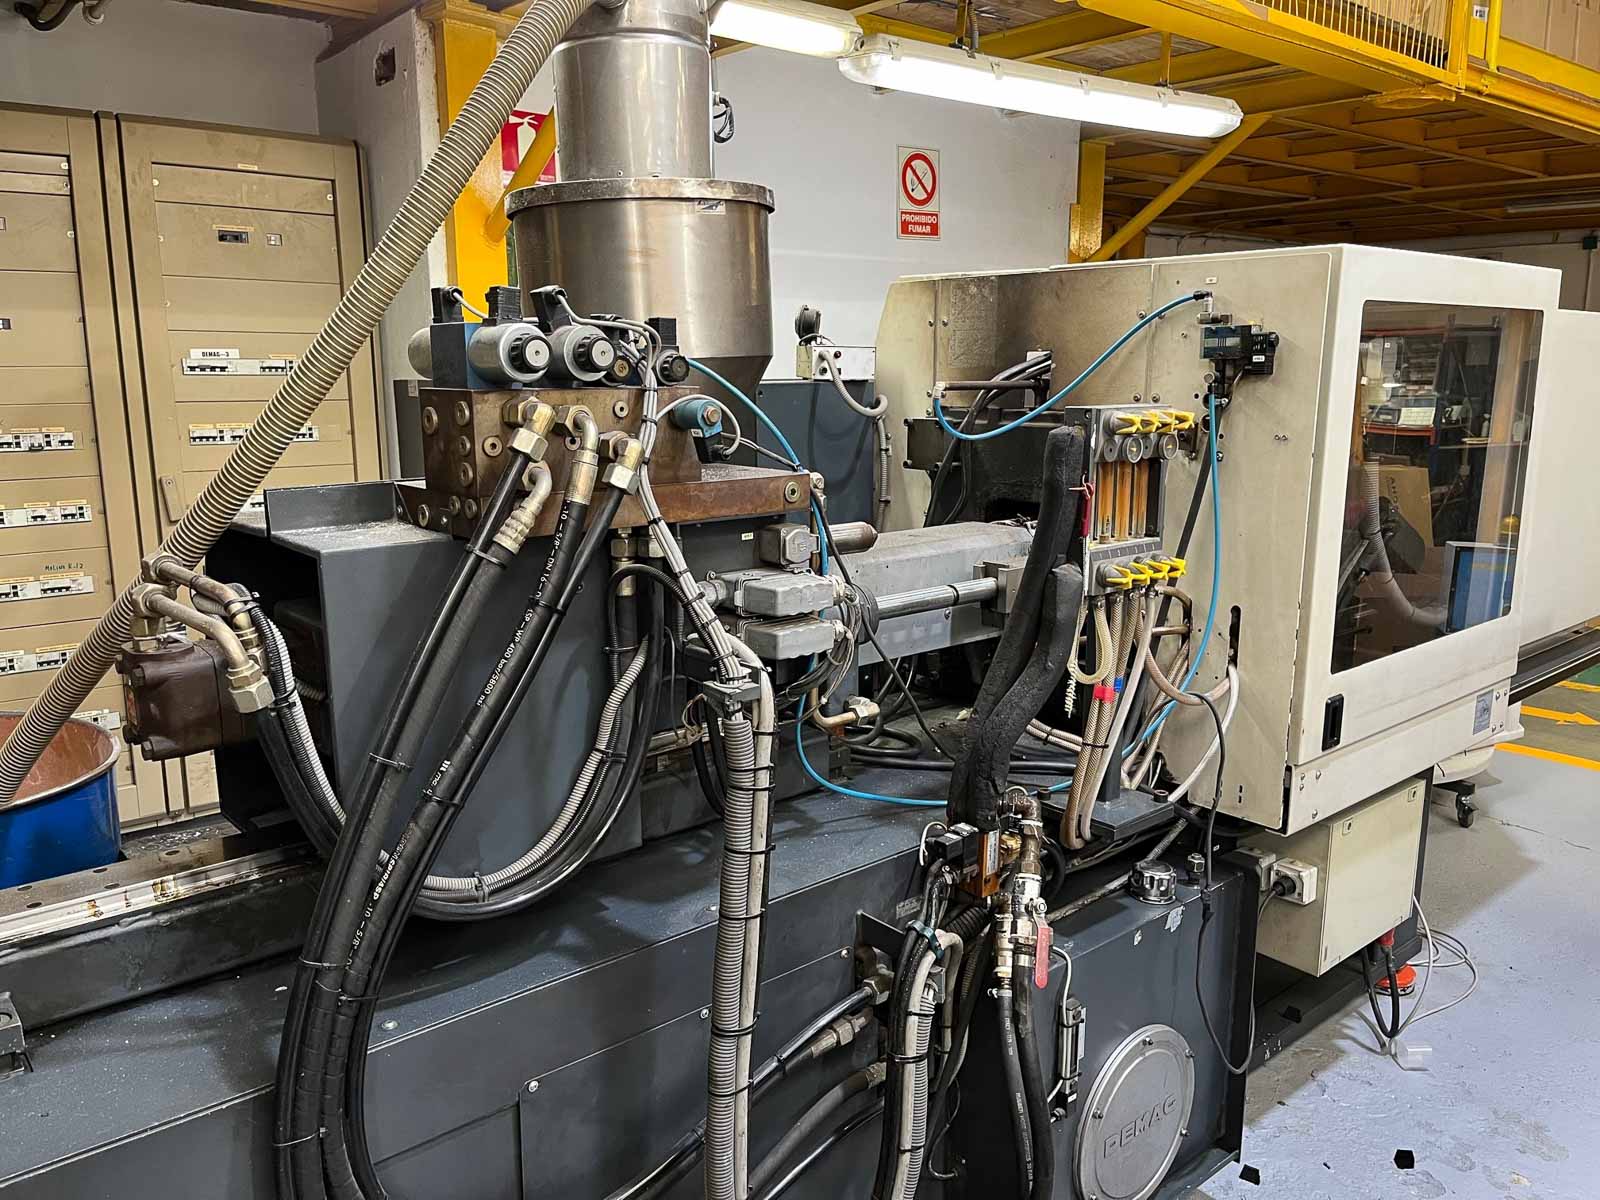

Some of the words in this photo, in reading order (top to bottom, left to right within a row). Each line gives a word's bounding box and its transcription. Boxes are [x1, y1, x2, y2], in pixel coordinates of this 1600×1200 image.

[902, 214, 937, 224] PROHIBIDO
[908, 225, 931, 233] FUMAR
[504, 642, 515, 658] 400
[1104, 1094, 1177, 1159] DEMAG
